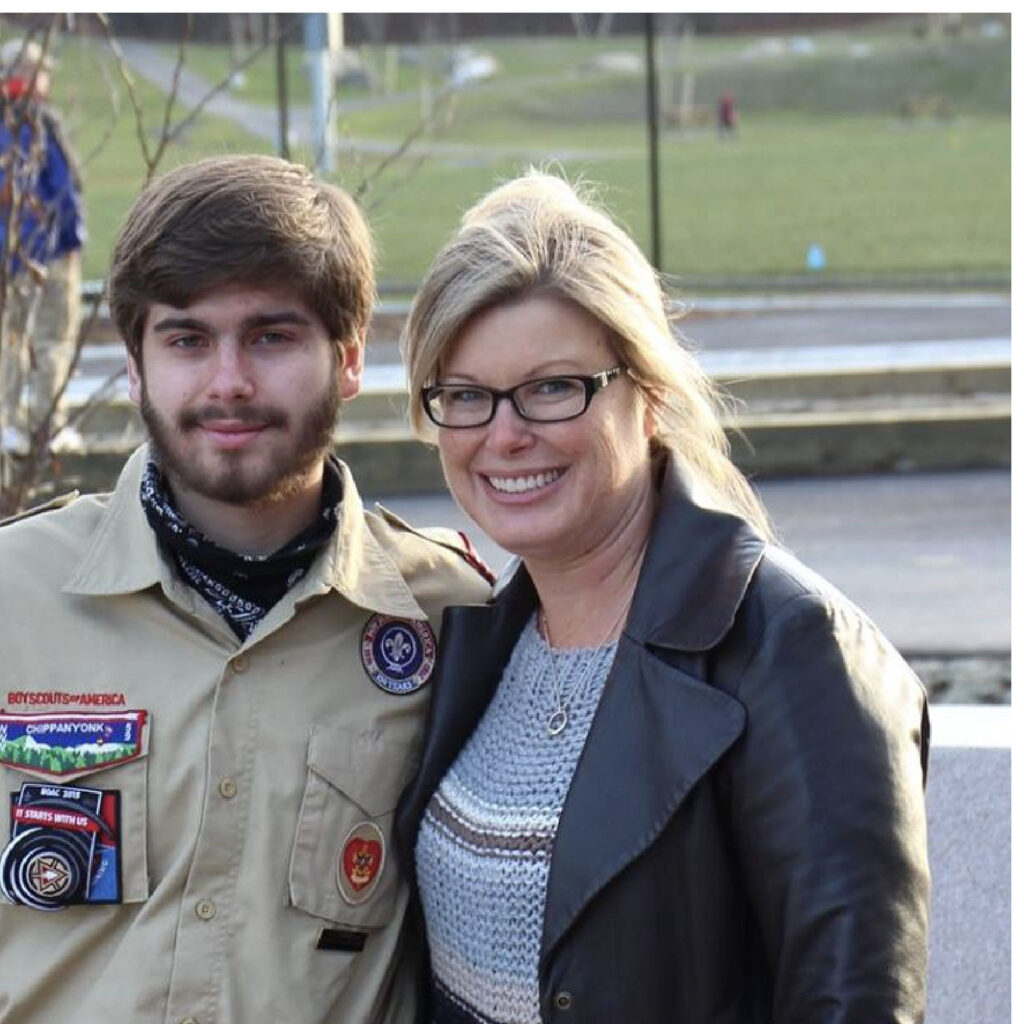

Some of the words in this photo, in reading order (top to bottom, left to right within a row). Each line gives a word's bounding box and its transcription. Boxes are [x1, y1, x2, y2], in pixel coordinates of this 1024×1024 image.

[26, 723, 104, 735] CHIPPANYONK
[24, 809, 53, 821] STARTS
[54, 813, 76, 825] WITH
[77, 816, 88, 827] US
